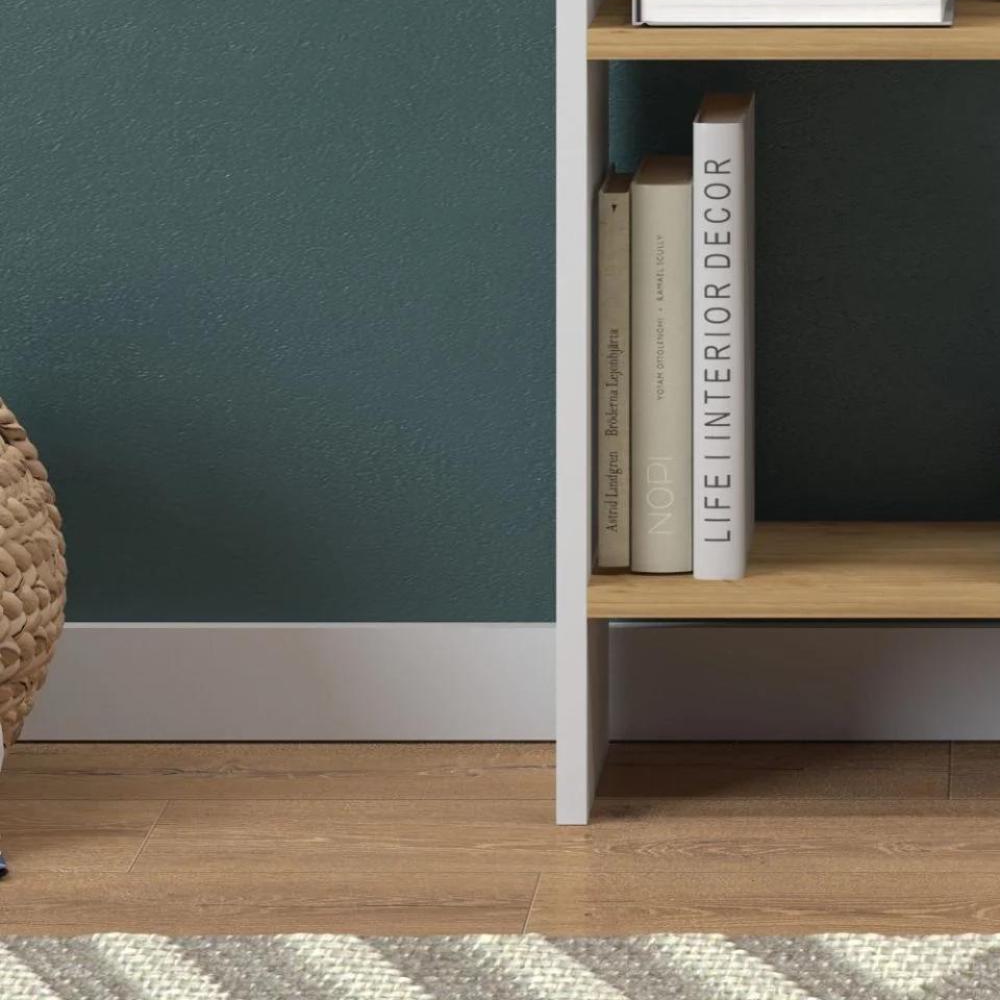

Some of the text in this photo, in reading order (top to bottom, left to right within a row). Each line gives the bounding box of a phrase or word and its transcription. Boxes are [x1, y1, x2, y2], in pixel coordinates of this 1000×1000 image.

[704, 158, 731, 269] DECOR
[704, 283, 731, 440] INTERIOR
[604, 389, 620, 437] Bröderna
[604, 450, 622, 498] Lindgren
[646, 457, 675, 535] NOPI
[704, 474, 731, 542] LIFE
[605, 500, 619, 532] Astrid
